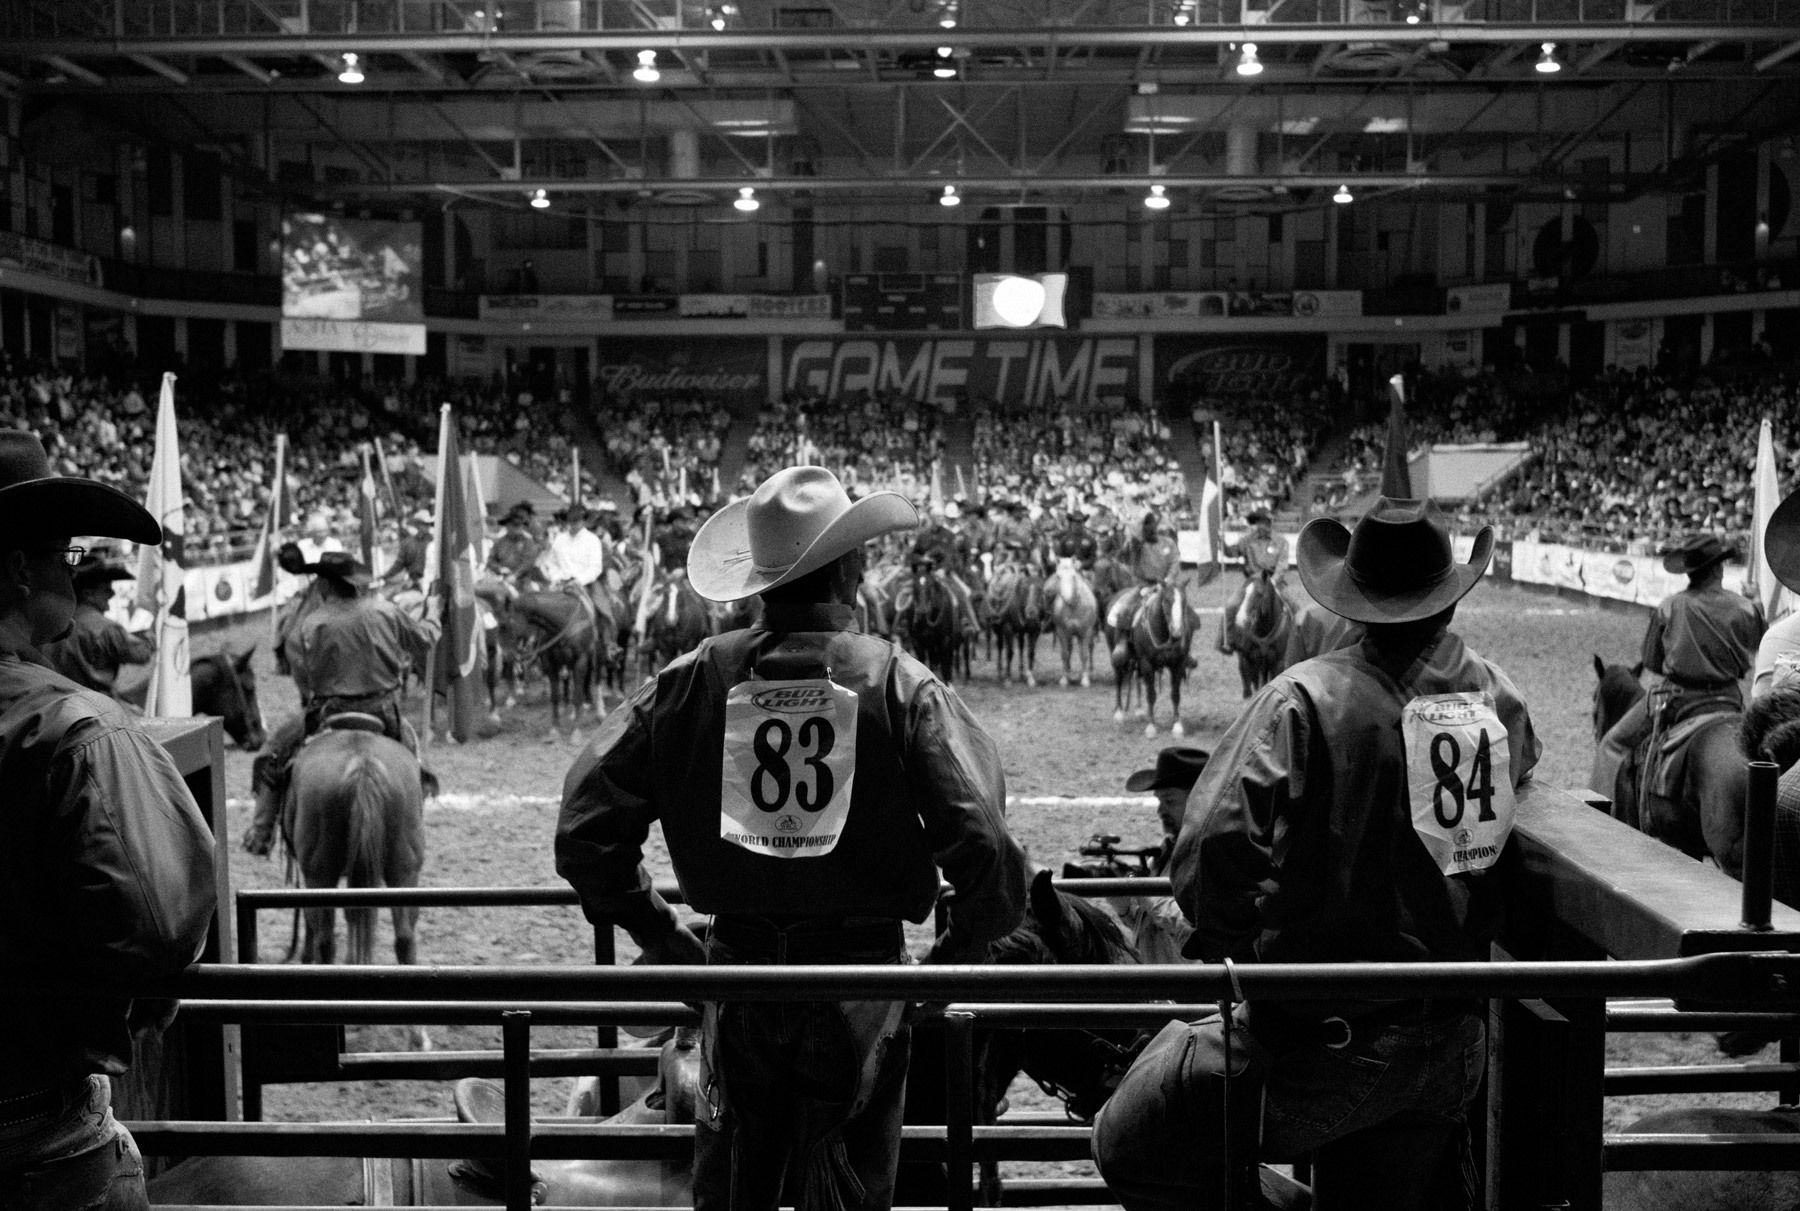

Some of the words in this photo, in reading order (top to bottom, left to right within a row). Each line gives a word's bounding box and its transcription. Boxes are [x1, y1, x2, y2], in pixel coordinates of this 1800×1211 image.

[601, 364, 760, 393] Budweiser
[788, 339, 975, 405] GAME
[987, 339, 1136, 407] TIME
[764, 698, 833, 707] LIGHT
[774, 689, 825, 698] BUD
[750, 716, 836, 813] 83
[1430, 728, 1497, 829] 84
